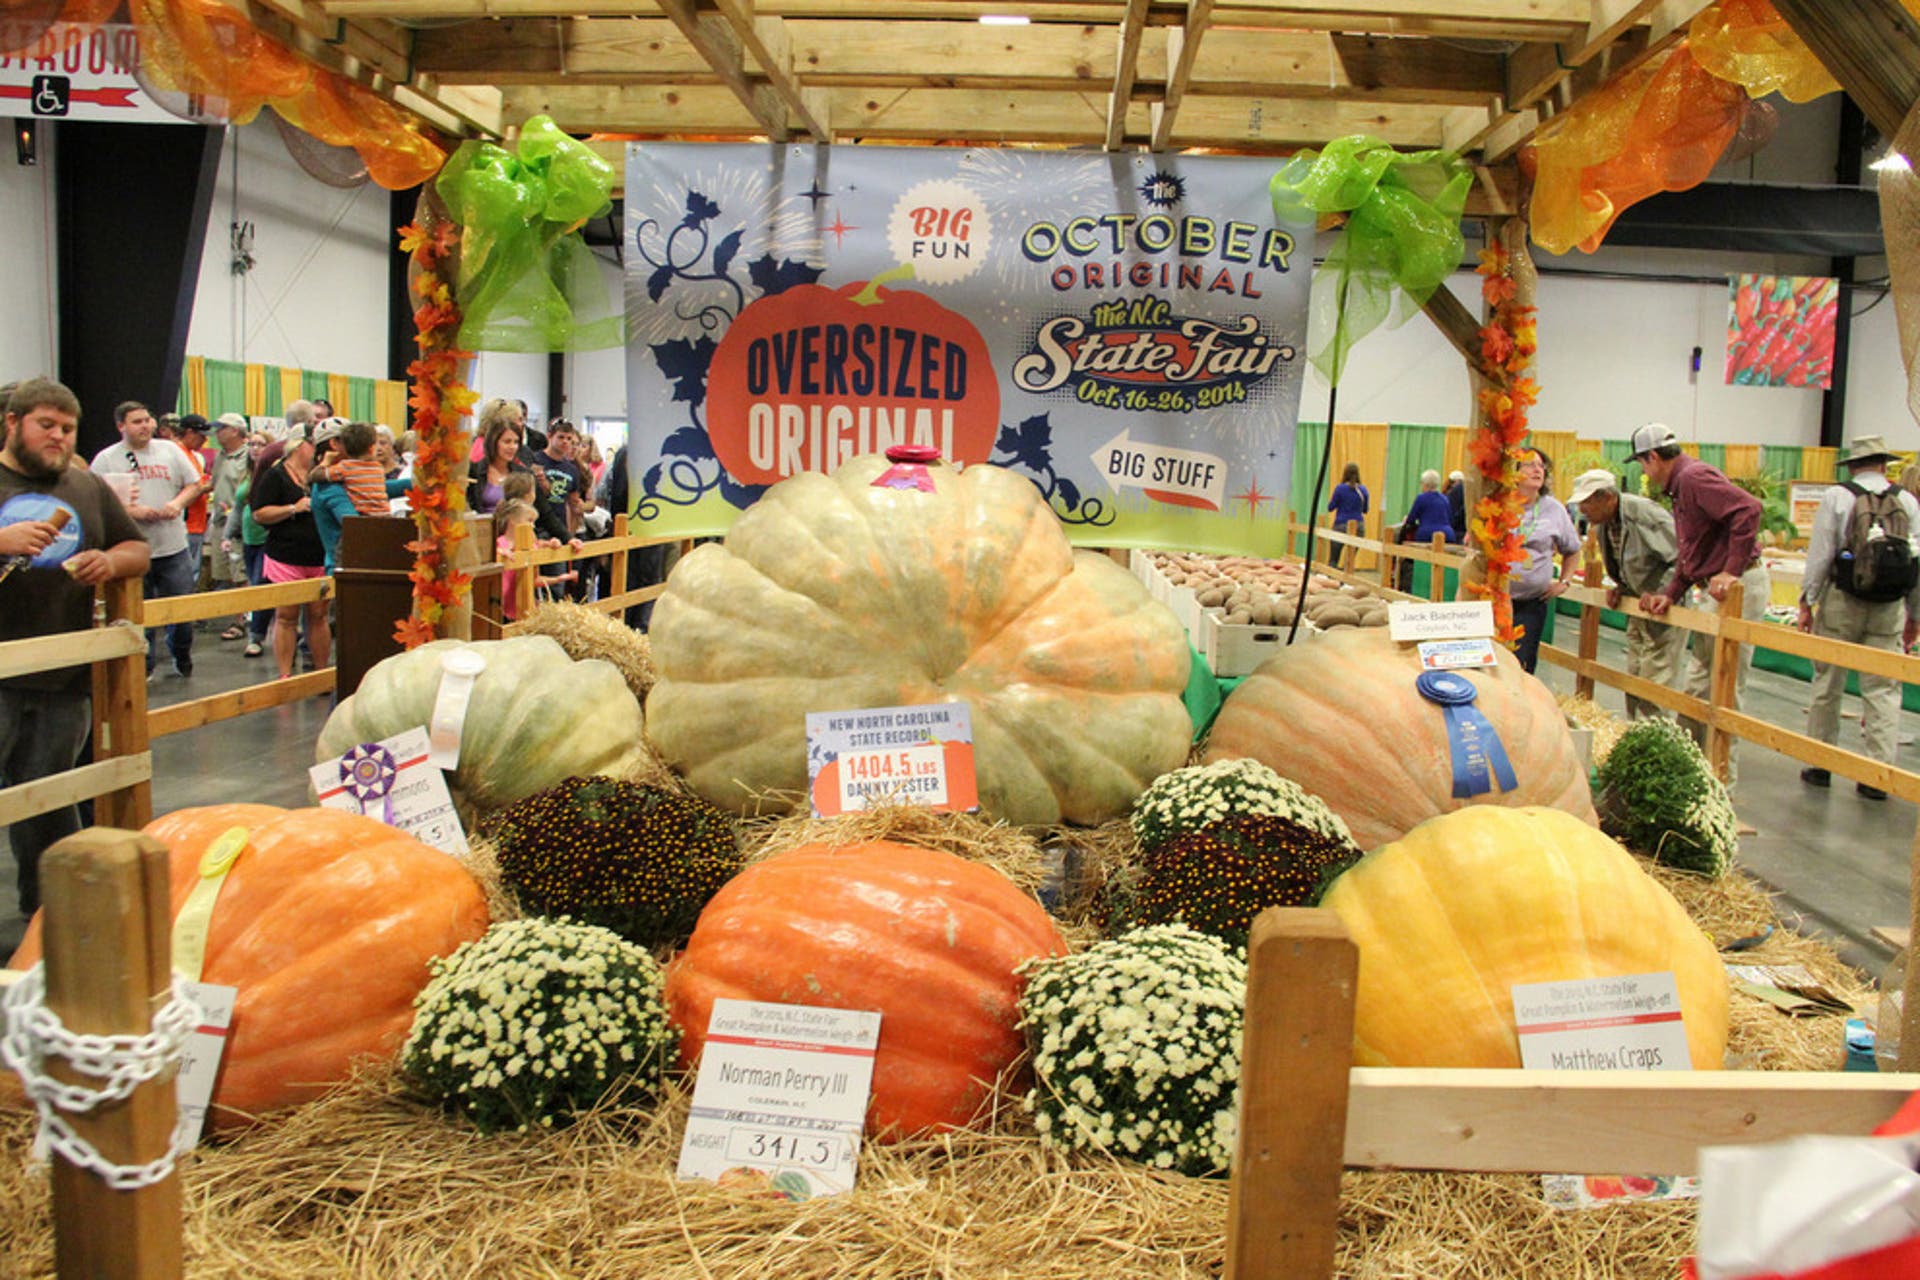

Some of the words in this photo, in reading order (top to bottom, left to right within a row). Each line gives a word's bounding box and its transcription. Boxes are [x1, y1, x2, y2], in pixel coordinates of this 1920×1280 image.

[909, 207, 972, 241] BIG
[913, 242, 970, 259] FUN
[1021, 213, 1296, 273] OCTOBER
[1052, 262, 1262, 299] ORIGINAL
[747, 323, 968, 401] OVERSIZED
[1012, 316, 1174, 393] State
[1164, 315, 1295, 382] Fair
[1077, 380, 1119, 410] Oct.
[1124, 389, 1192, 413] 16-26,
[1196, 380, 1247, 408] 2014
[1109, 449, 1146, 479] BIG
[1151, 456, 1216, 490] STUFF
[1402, 610, 1429, 622] Jack
[829, 716, 855, 731] NEW
[856, 713, 894, 730] NORTH
[895, 711, 950, 727] CAROLINA
[849, 732, 882, 747] STATE
[885, 727, 932, 745] RECORD!
[848, 752, 912, 780] 1404.5
[847, 779, 889, 798] DANNY
[1551, 1048, 1617, 1070] Matthew
[1618, 1046, 1664, 1069] Craps
[719, 1062, 782, 1089] Norman
[785, 1068, 830, 1097] Perry
[831, 1072, 849, 1095] III
[689, 1133, 726, 1149] WEIGHT
[748, 1134, 830, 1166] 341.5
